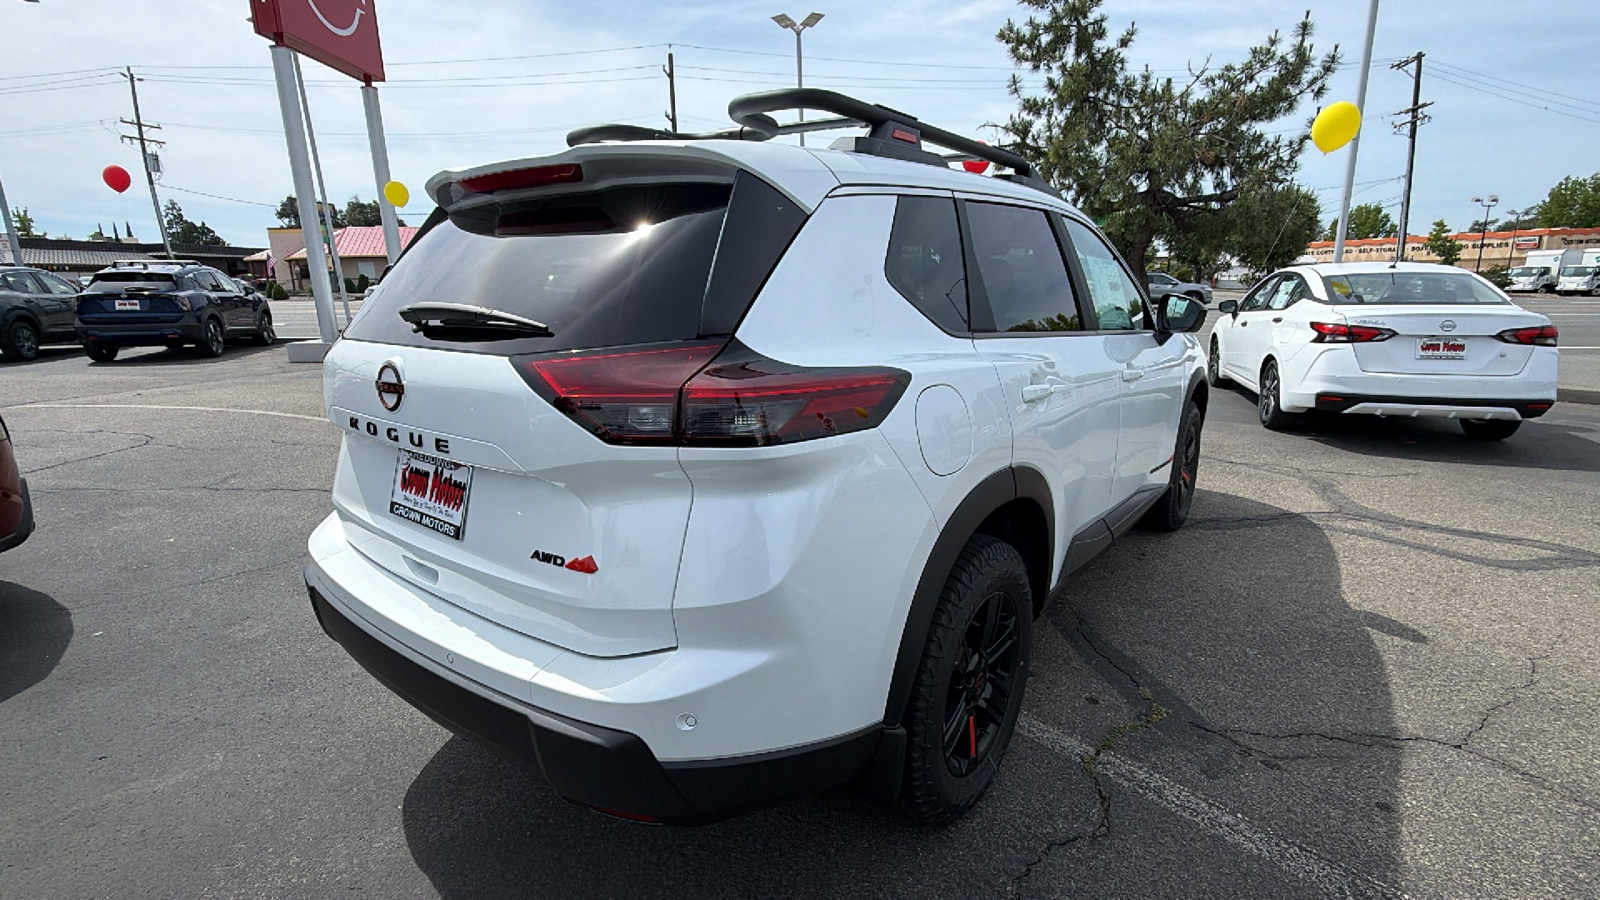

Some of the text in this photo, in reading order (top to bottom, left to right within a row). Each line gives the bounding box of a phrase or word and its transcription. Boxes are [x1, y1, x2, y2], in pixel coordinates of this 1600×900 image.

[1358, 246, 1397, 254] SELF-STORA
[349, 416, 450, 454] ROGUE
[412, 452, 452, 469] REDDING
[393, 504, 456, 536] CROWN MOTORS
[530, 549, 565, 567] AWD
